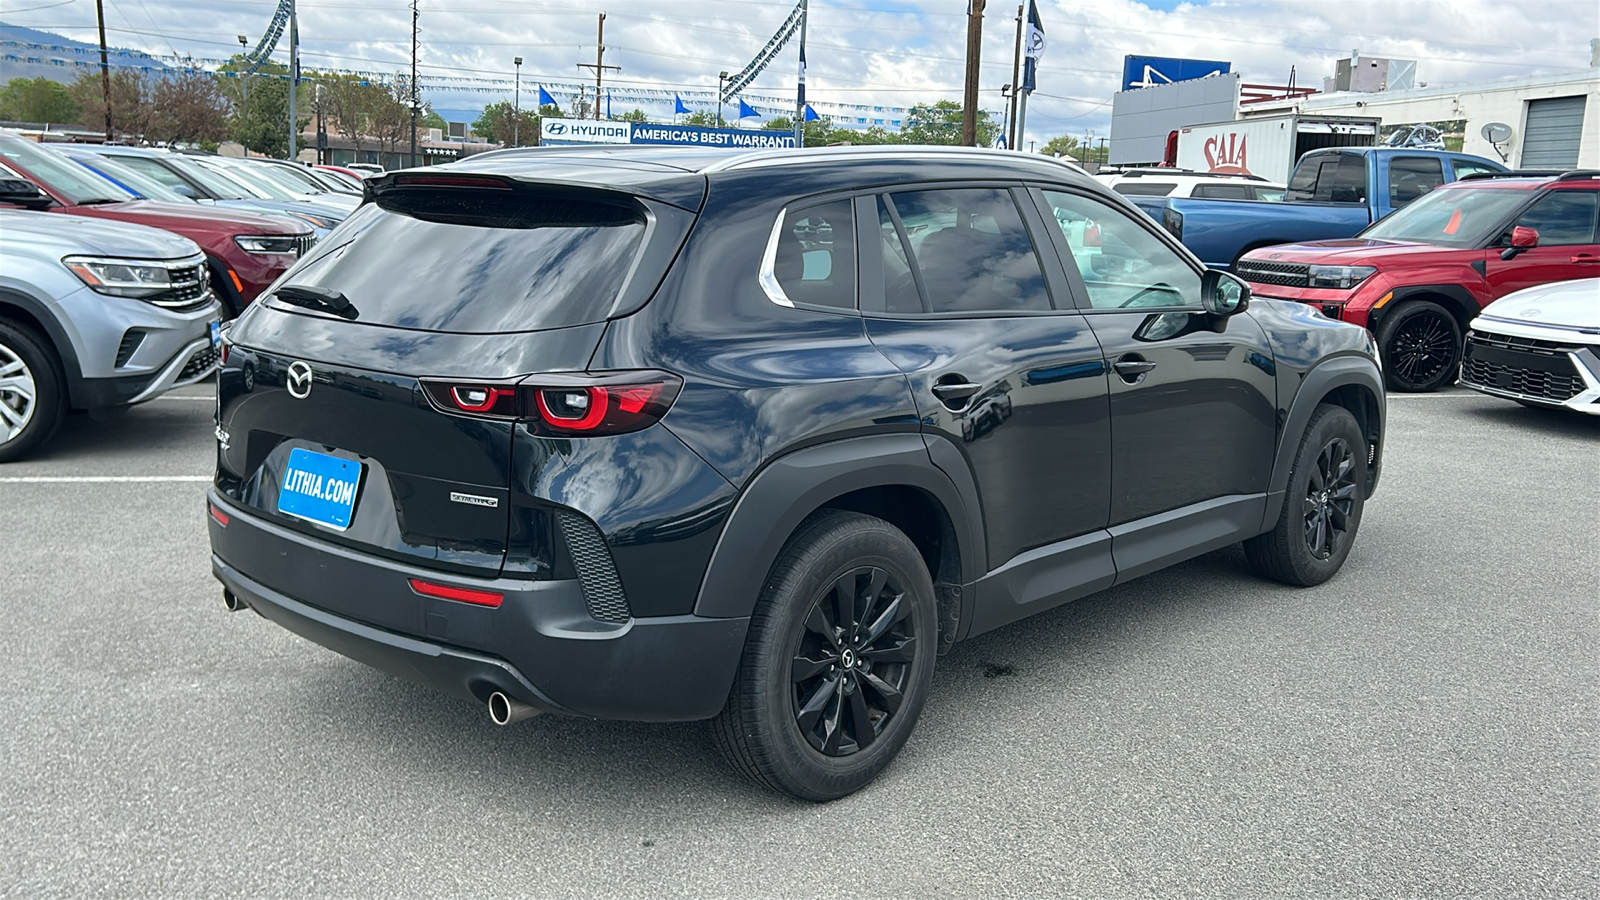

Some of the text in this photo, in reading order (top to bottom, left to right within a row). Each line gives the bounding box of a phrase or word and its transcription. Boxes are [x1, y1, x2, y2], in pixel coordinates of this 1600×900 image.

[571, 125, 628, 137] HYUNDAI
[633, 128, 699, 143] AMERICA'S
[700, 132, 730, 144] BEST
[1203, 132, 1248, 170] SAIA
[283, 467, 355, 506] LITHIA.COM
